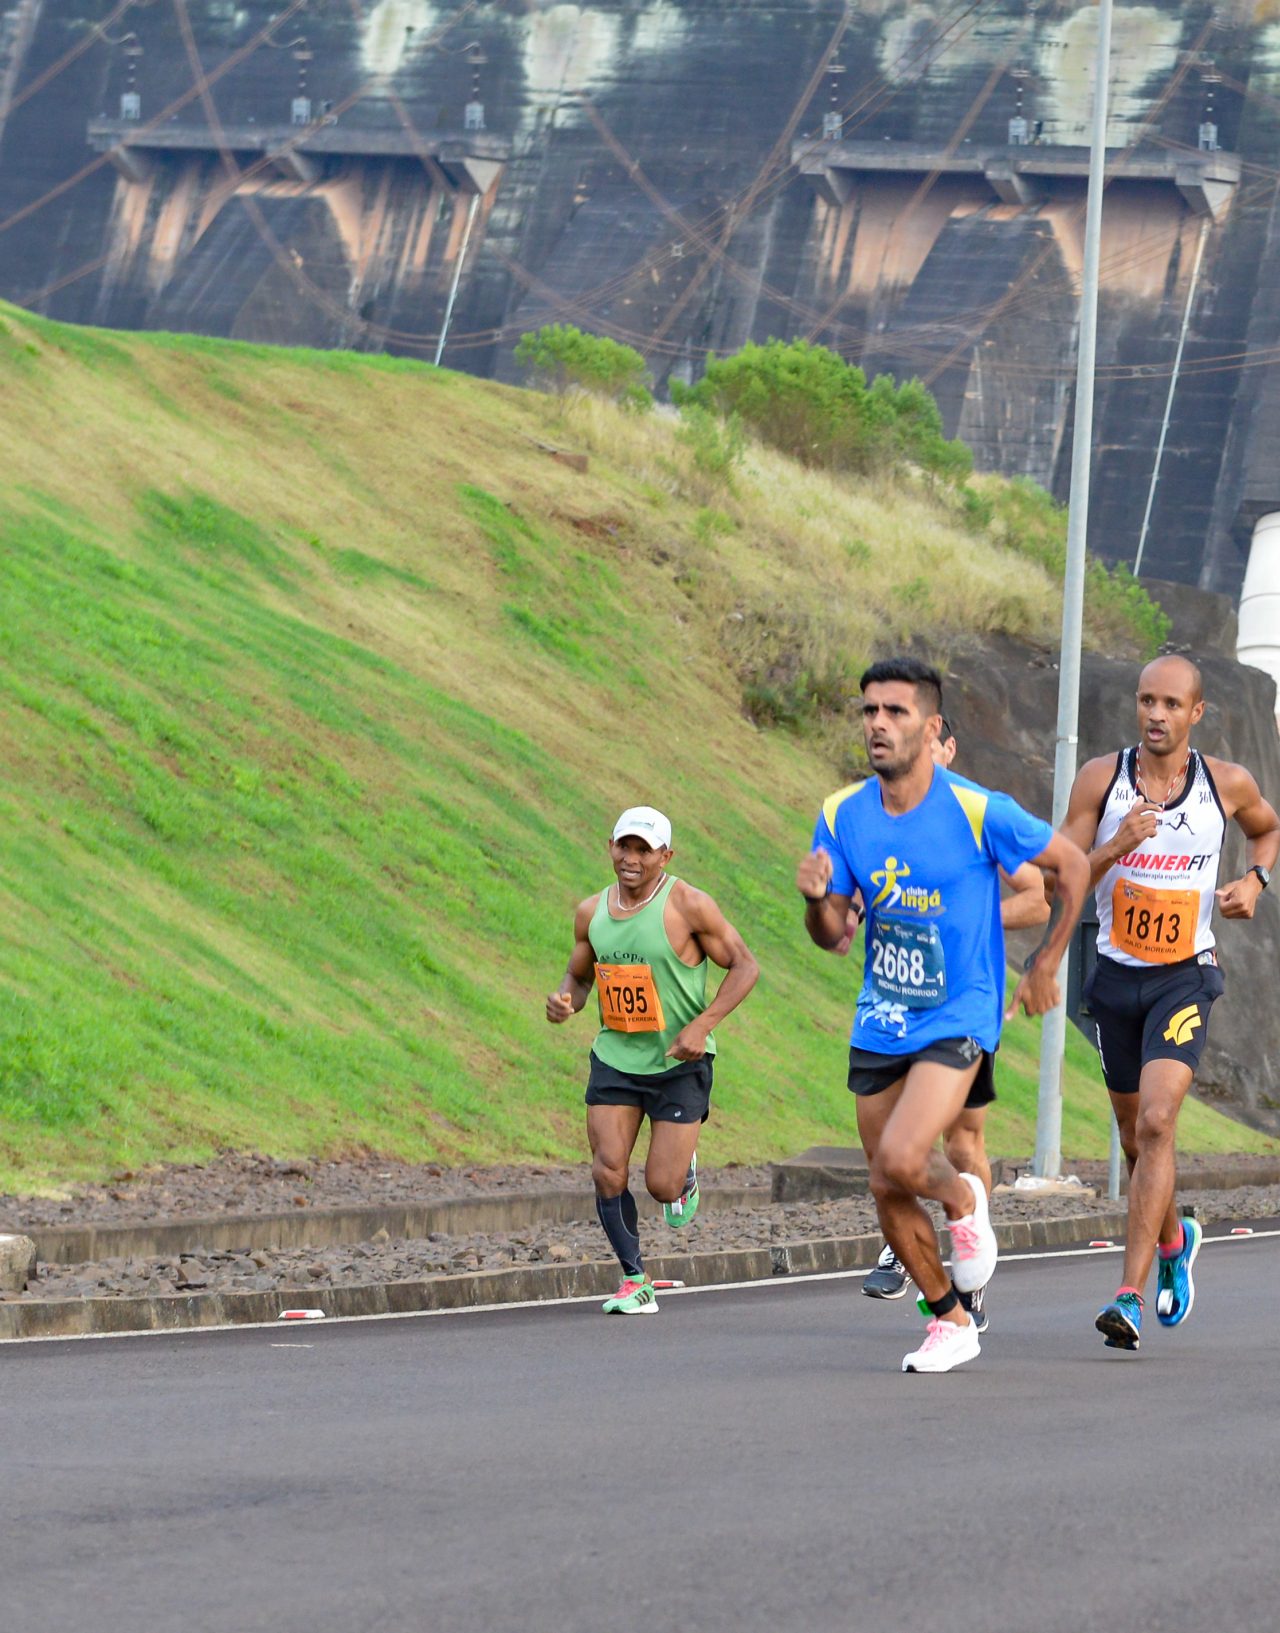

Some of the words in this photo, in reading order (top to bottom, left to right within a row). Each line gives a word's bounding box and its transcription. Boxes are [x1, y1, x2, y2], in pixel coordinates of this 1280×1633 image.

[901, 889, 941, 913] Ingá
[1124, 906, 1181, 944] 1813
[606, 985, 648, 1014] 1795
[901, 985, 938, 997] RODRIGO
